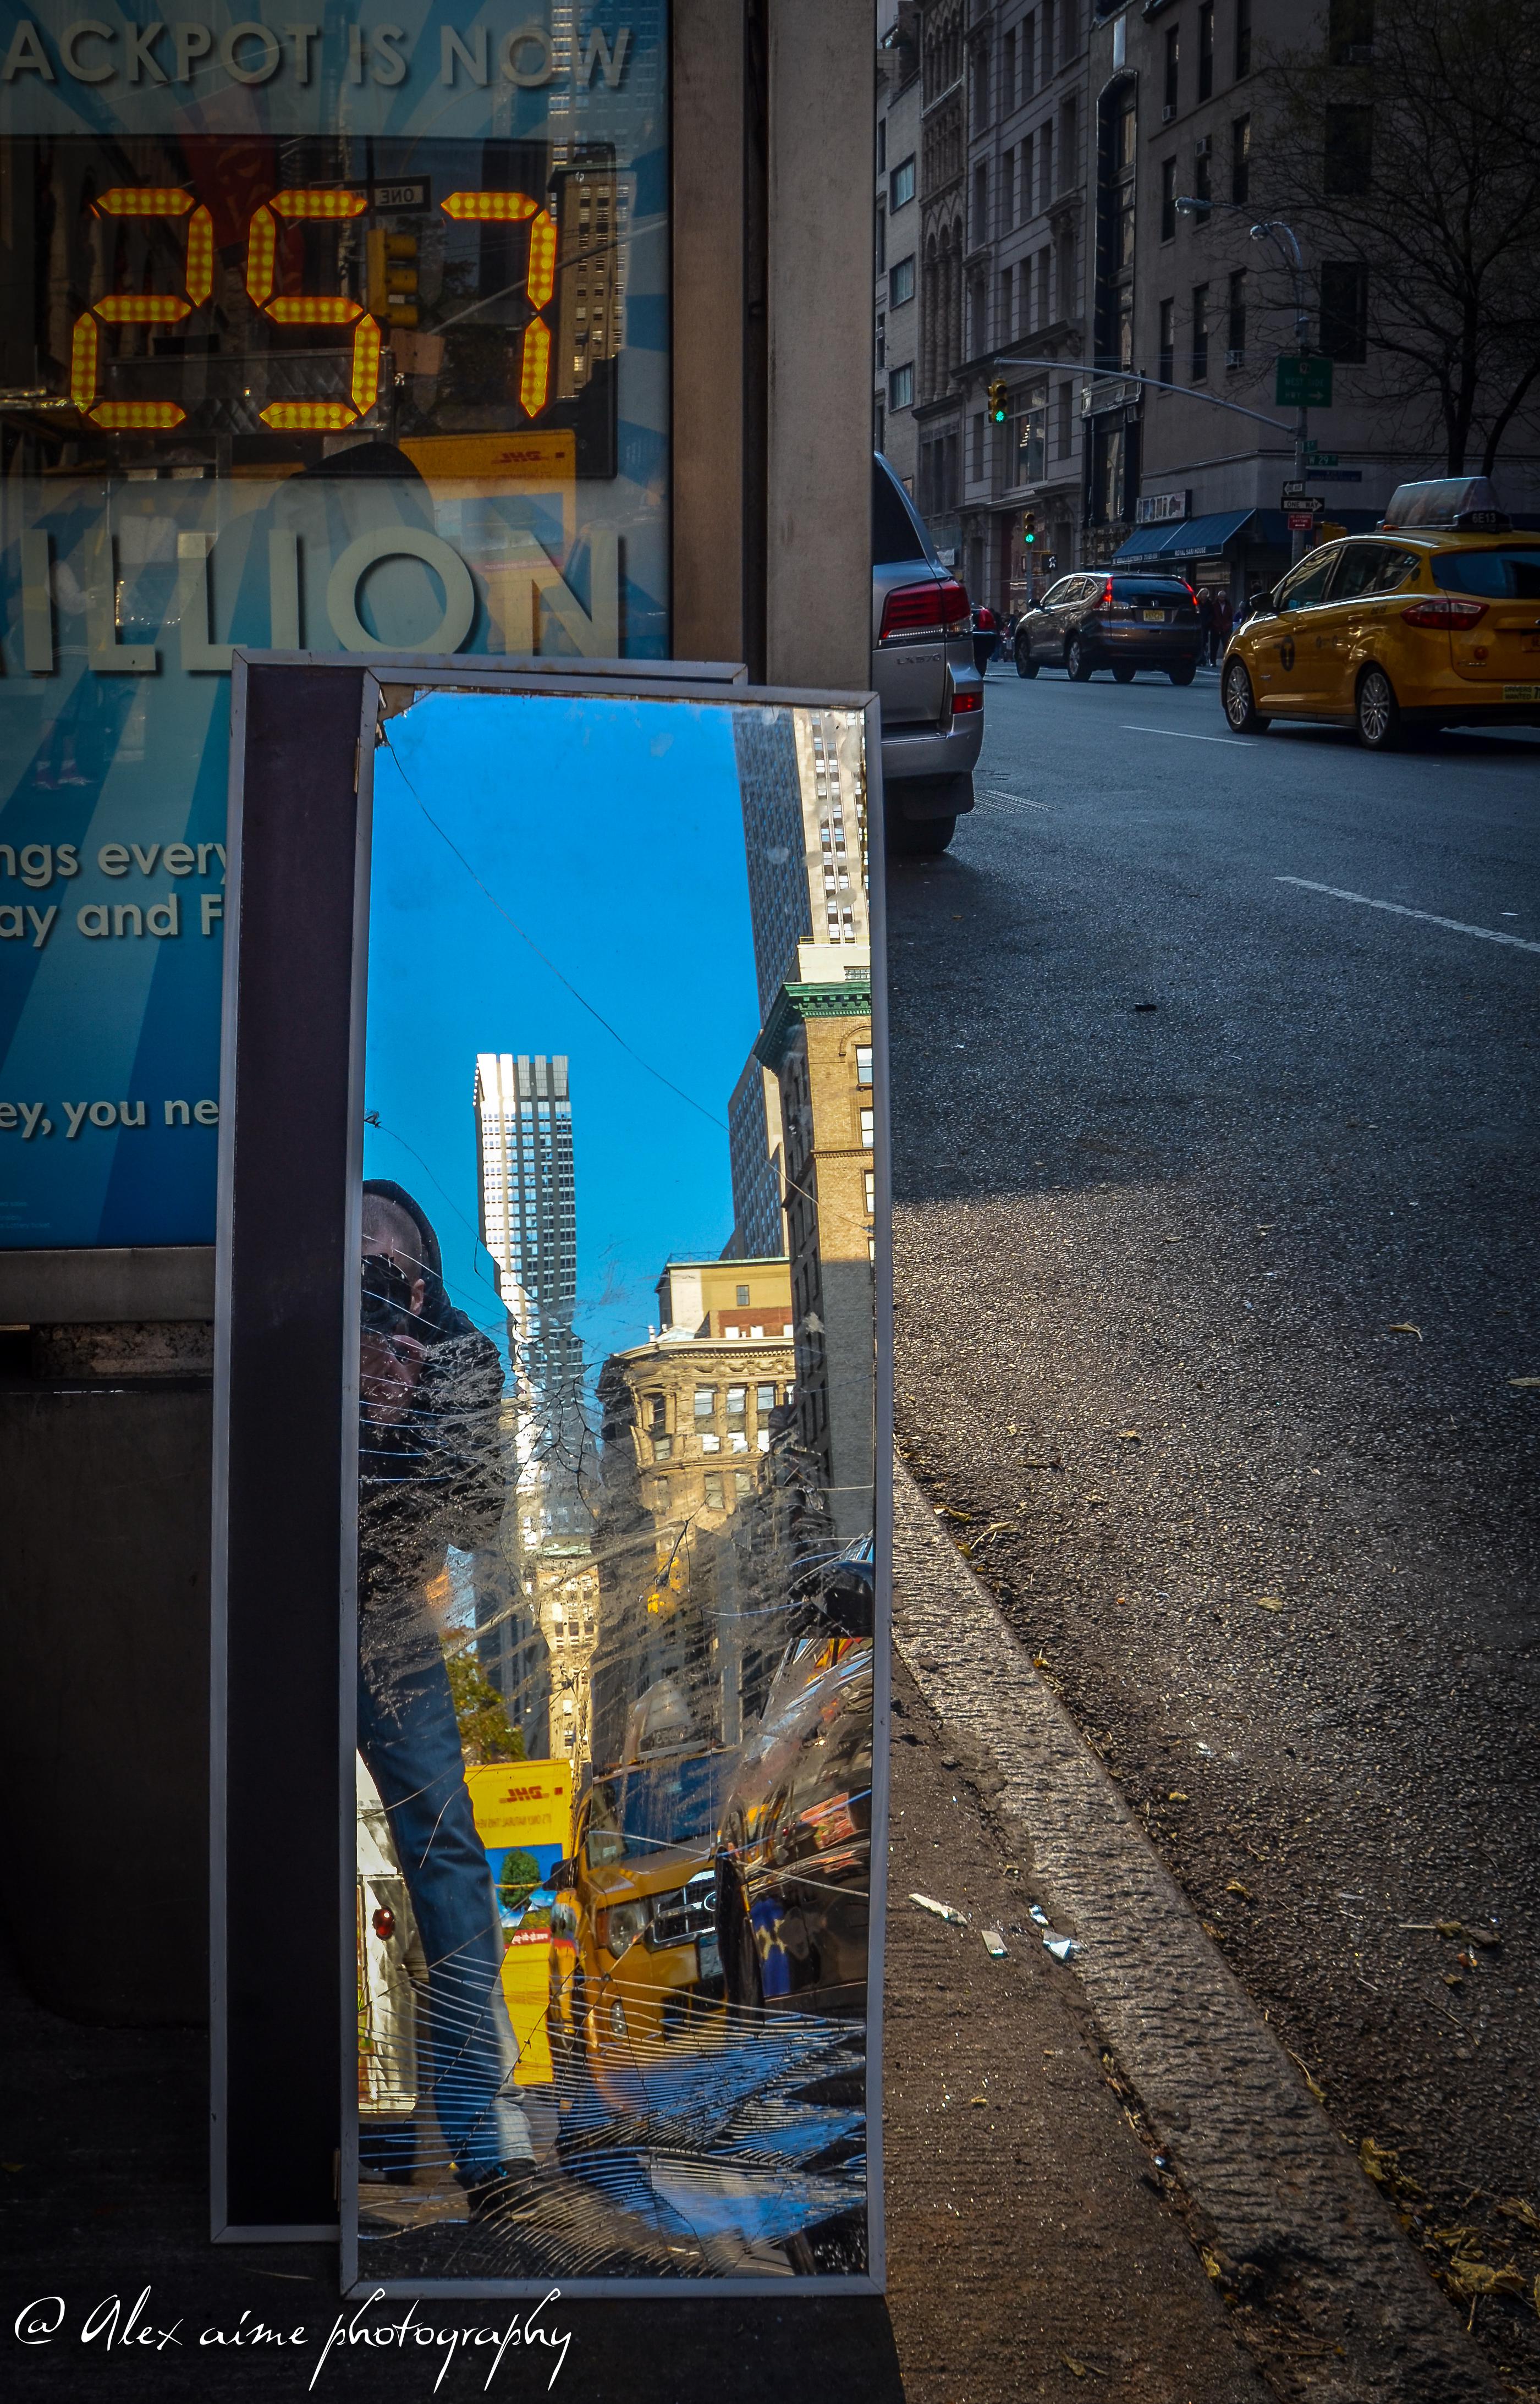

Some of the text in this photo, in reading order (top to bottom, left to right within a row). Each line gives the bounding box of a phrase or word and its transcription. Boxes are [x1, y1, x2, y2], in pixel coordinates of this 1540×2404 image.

[1, 20, 633, 89] ACKPOT IS NOW
[71, 188, 557, 430] 257
[1285, 378, 1325, 387] WEST SIDE
[1308, 455, 1316, 465] W
[1318, 455, 1329, 465] 29
[1472, 512, 1497, 524] 6E13
[897, 653, 942, 665] LX570
[77, 894, 179, 936] and
[63, 1102, 146, 1137] you
